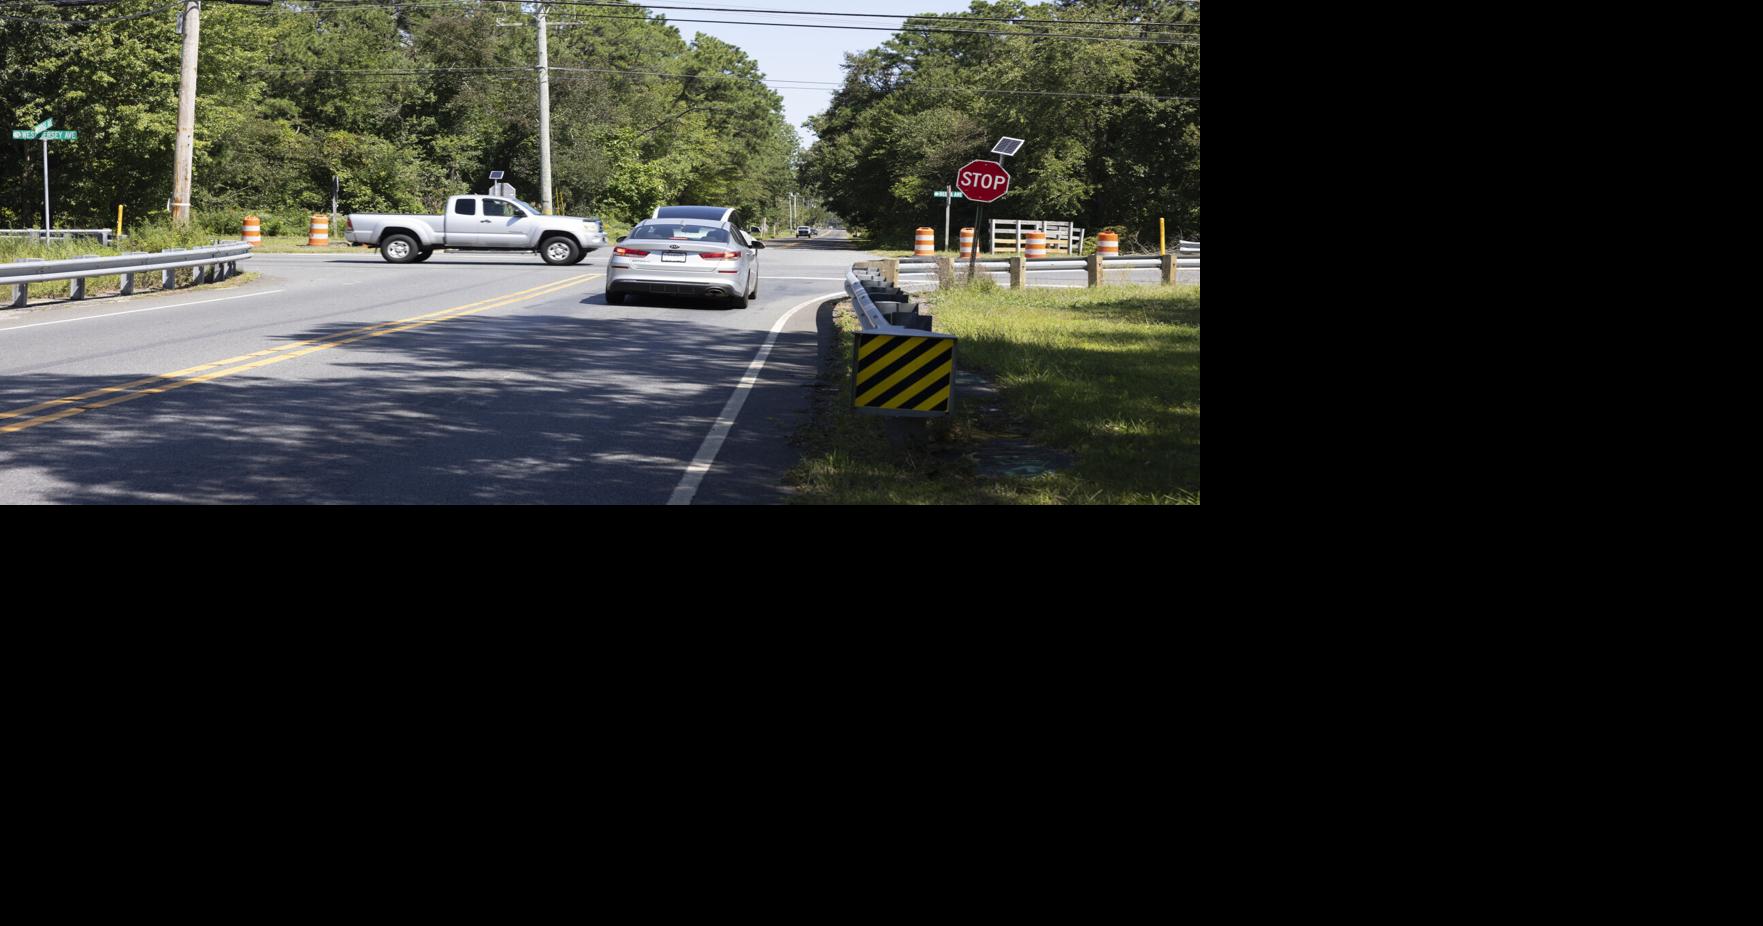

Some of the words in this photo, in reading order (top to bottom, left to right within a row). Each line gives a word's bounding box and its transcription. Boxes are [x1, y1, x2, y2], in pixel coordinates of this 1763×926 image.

[22, 130, 38, 139] WES
[42, 130, 63, 139] ERSEY
[65, 130, 77, 139] AVE
[961, 171, 1006, 190] STOP
